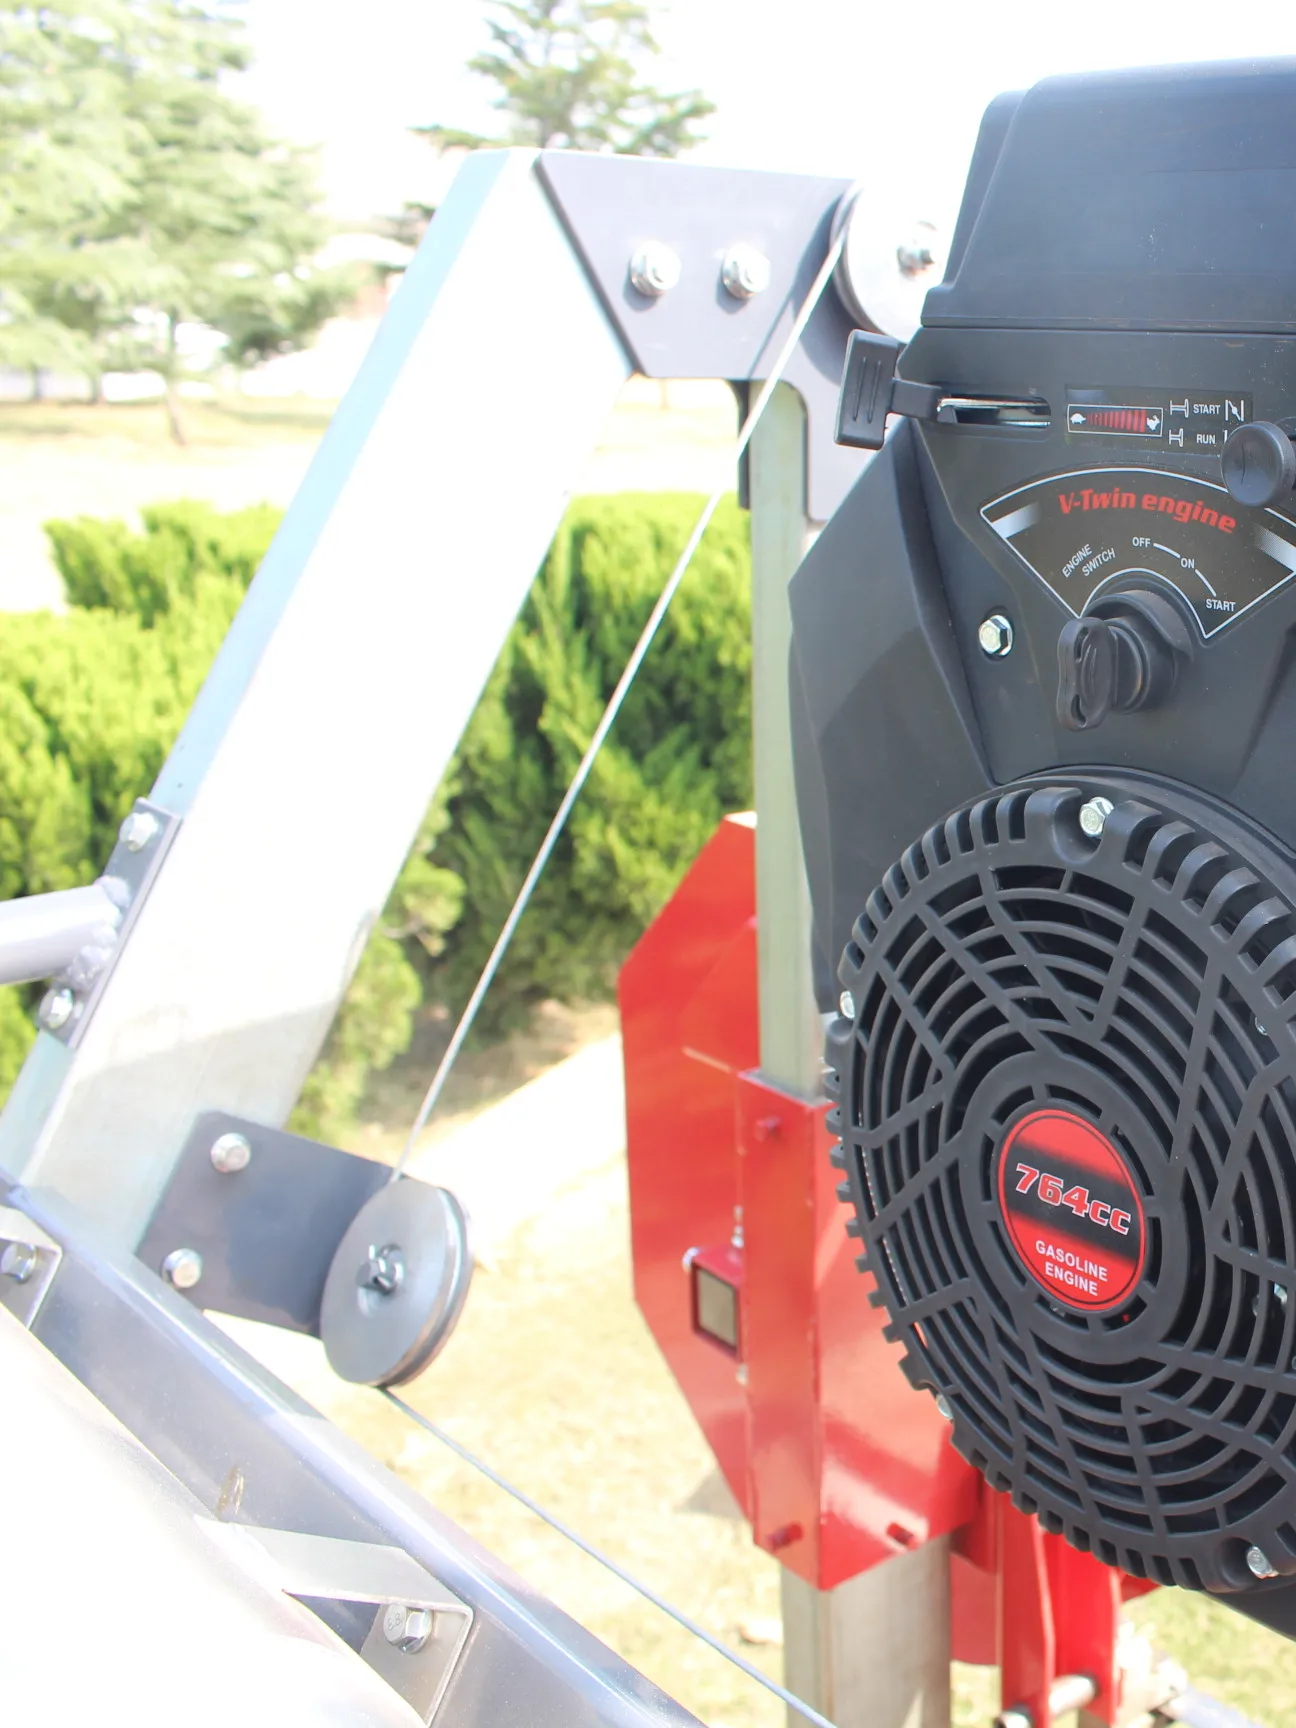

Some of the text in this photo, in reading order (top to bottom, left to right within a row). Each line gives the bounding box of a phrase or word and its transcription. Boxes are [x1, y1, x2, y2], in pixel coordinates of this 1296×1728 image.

[1193, 404, 1221, 415] START
[1196, 434, 1216, 445] RUN
[1058, 487, 1236, 534] V-Twin engine
[1132, 537, 1151, 548] OFF
[1061, 543, 1093, 578] ENGINE
[1081, 548, 1116, 577] SWITCH
[1180, 557, 1195, 569] ON
[1205, 598, 1236, 612] START
[1015, 1163, 1131, 1235] 764cc
[1035, 1240, 1108, 1281] GASOLINE
[1045, 1261, 1098, 1296] ENGINE
